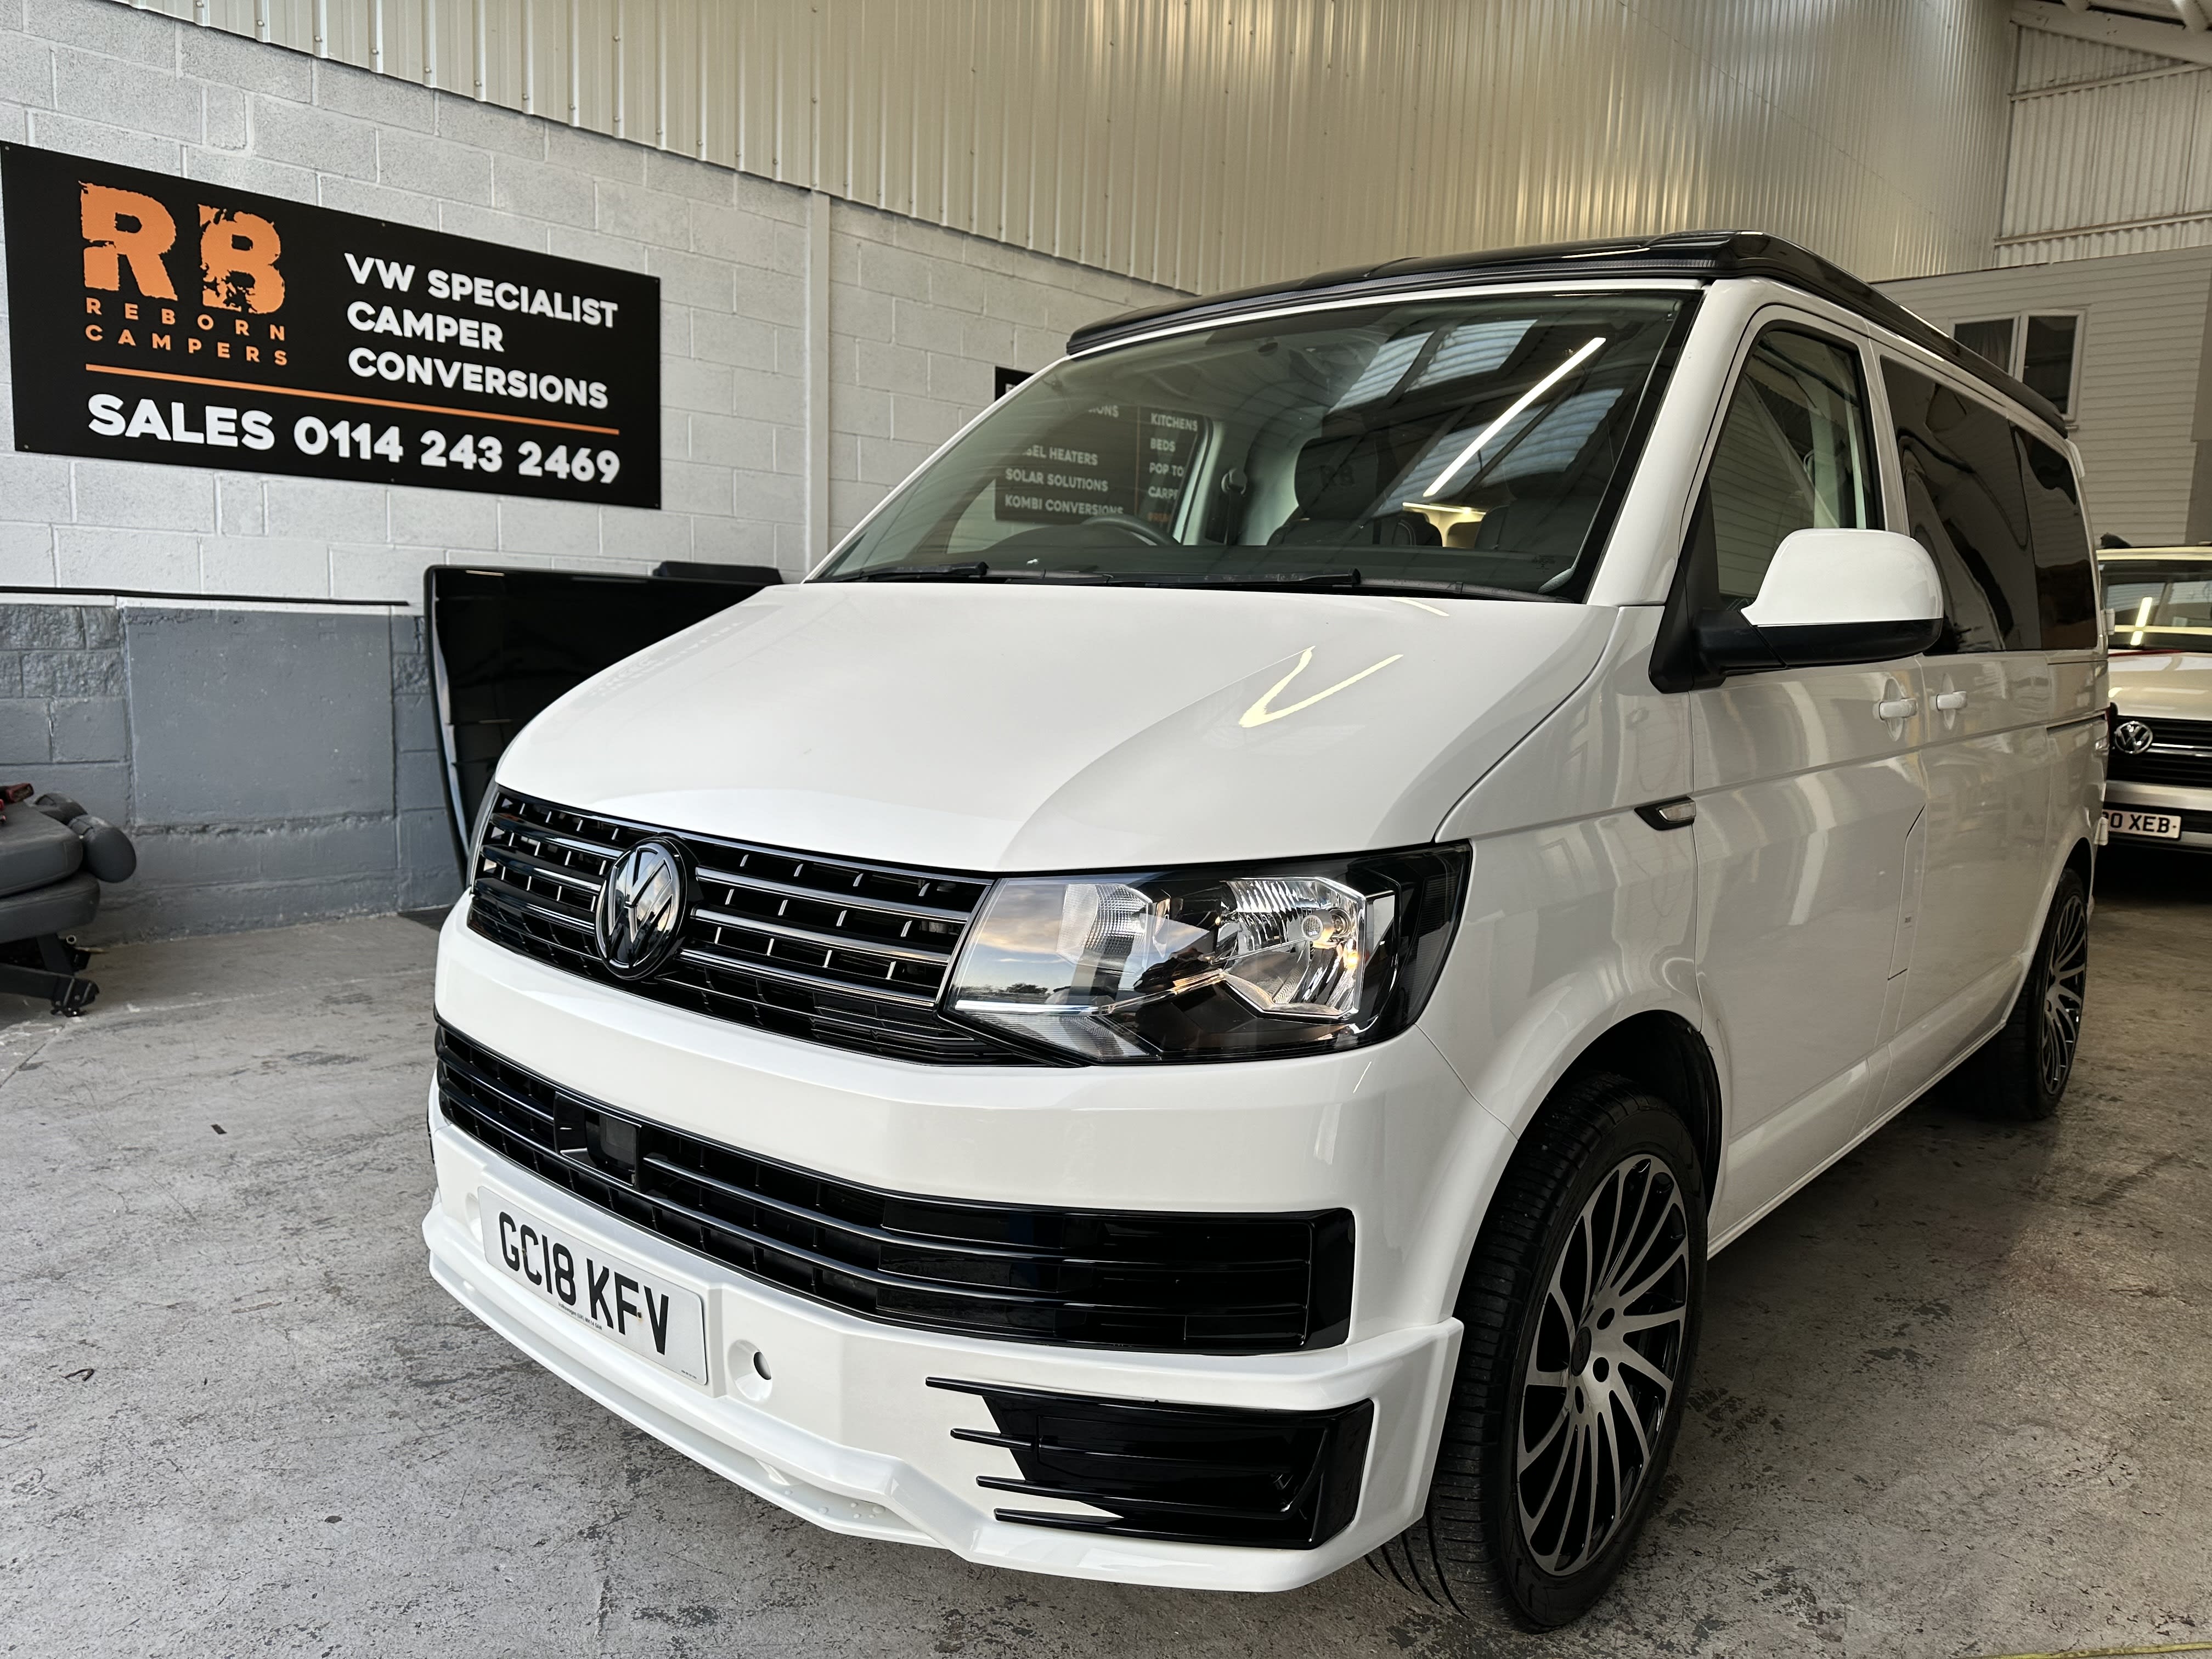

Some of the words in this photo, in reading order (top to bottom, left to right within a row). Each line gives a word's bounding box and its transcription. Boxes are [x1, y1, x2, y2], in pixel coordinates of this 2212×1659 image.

[344, 252, 415, 292] VW
[427, 269, 618, 328] SPECIALIST
[86, 297, 285, 341] REBORN
[347, 301, 504, 352] CAMPER
[85, 324, 288, 366] CAMPERS
[348, 347, 608, 409] CONVERSIONS
[88, 393, 275, 451] SALES
[294, 415, 404, 463] 0114
[420, 429, 503, 472] 243
[518, 441, 620, 484] 2469
[1151, 413, 1198, 432] KITCHENS
[1049, 447, 1098, 466] HEATERS
[1150, 438, 1176, 453] BEDS
[1005, 468, 1044, 484] SOLAR
[1047, 473, 1109, 492] SOLUTIONS
[1149, 462, 1169, 475] POP
[1005, 494, 1042, 510] KOMBI
[1045, 499, 1124, 516] CONVERSIONS
[2128, 814, 2170, 833] XEB
[499, 1211, 577, 1307] GC18
[586, 1257, 669, 1356] KFV
